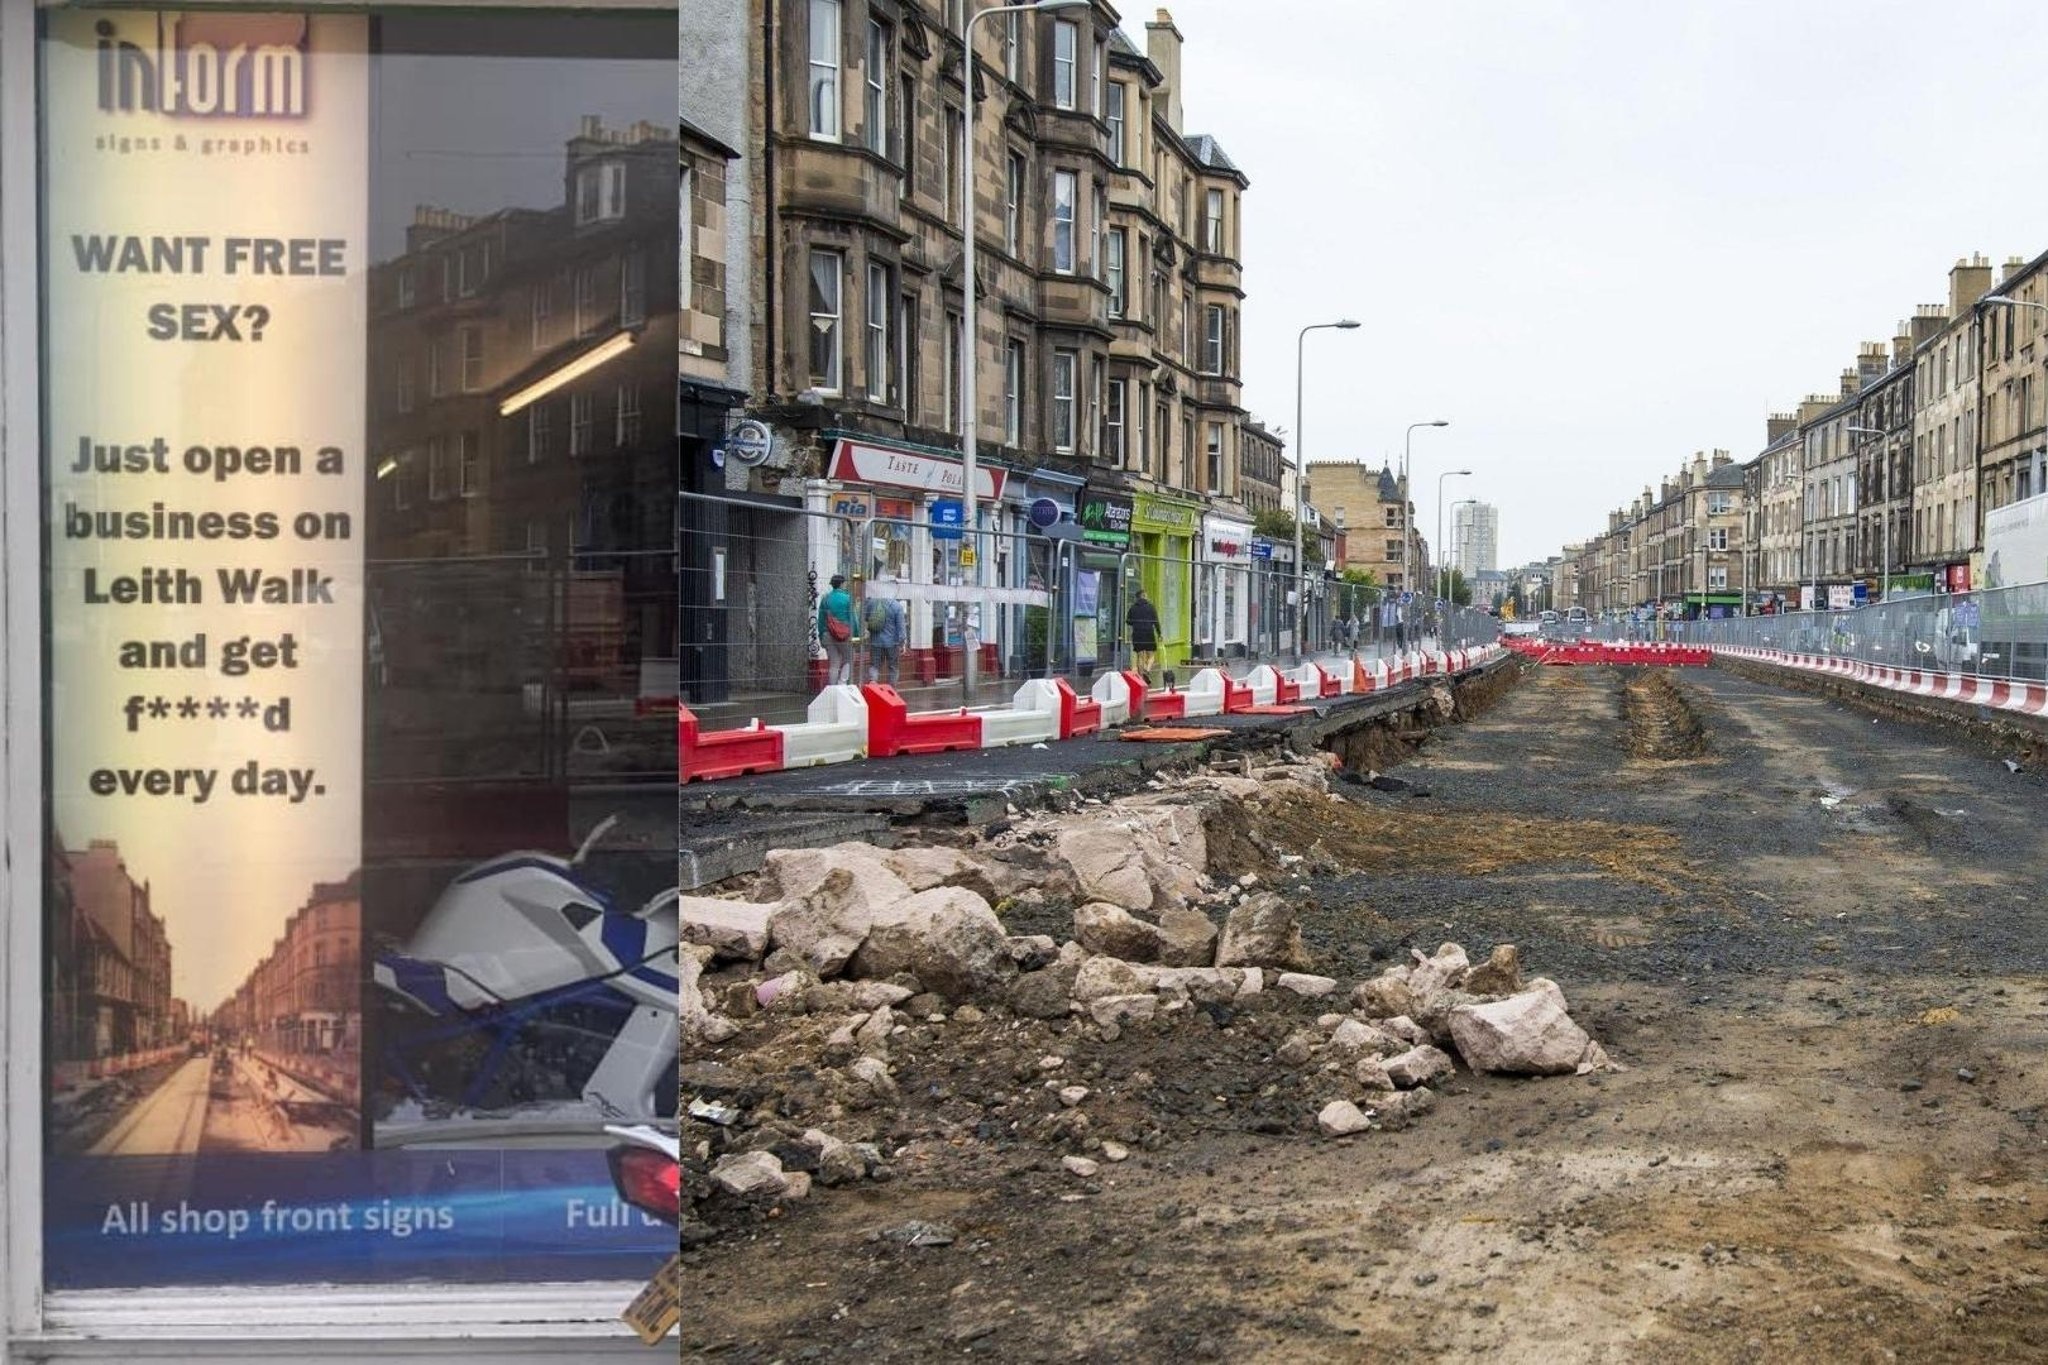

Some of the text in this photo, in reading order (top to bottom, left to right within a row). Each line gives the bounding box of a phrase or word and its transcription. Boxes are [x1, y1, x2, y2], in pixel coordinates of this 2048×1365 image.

[96, 12, 306, 115] inform
[96, 134, 309, 156] signs & graphics
[70, 234, 348, 277] WANT FREE
[147, 304, 271, 342] SEX?
[70, 436, 344, 483] Just open a
[65, 502, 351, 540] business on
[836, 499, 867, 515] Ria
[84, 568, 335, 606] Leith Walk
[119, 633, 298, 677] and get
[89, 761, 326, 804] every day.
[101, 1201, 149, 1235] All
[161, 1200, 251, 1240] shop
[260, 1199, 354, 1232] front
[363, 1198, 455, 1238] signs
[566, 1198, 629, 1229] Full
